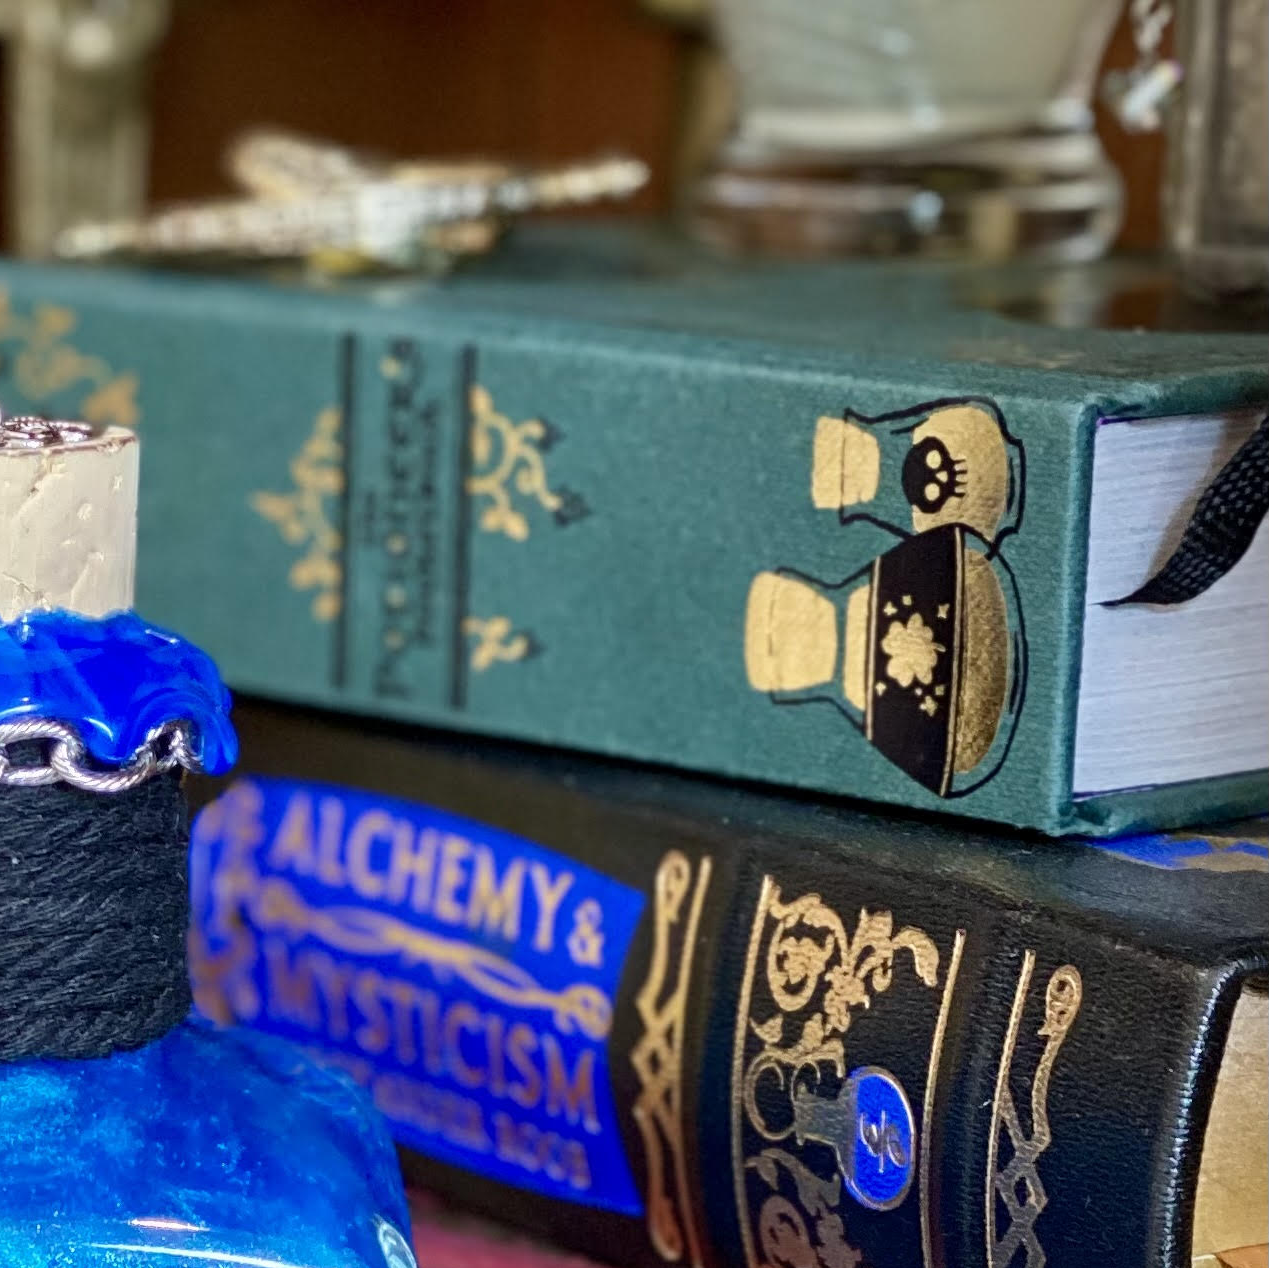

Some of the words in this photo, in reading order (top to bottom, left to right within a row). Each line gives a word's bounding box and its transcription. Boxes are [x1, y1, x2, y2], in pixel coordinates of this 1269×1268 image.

[268, 792, 574, 952] ALCHEMY
[566, 898, 604, 968] &
[263, 935, 602, 1135] MYSTICISM
